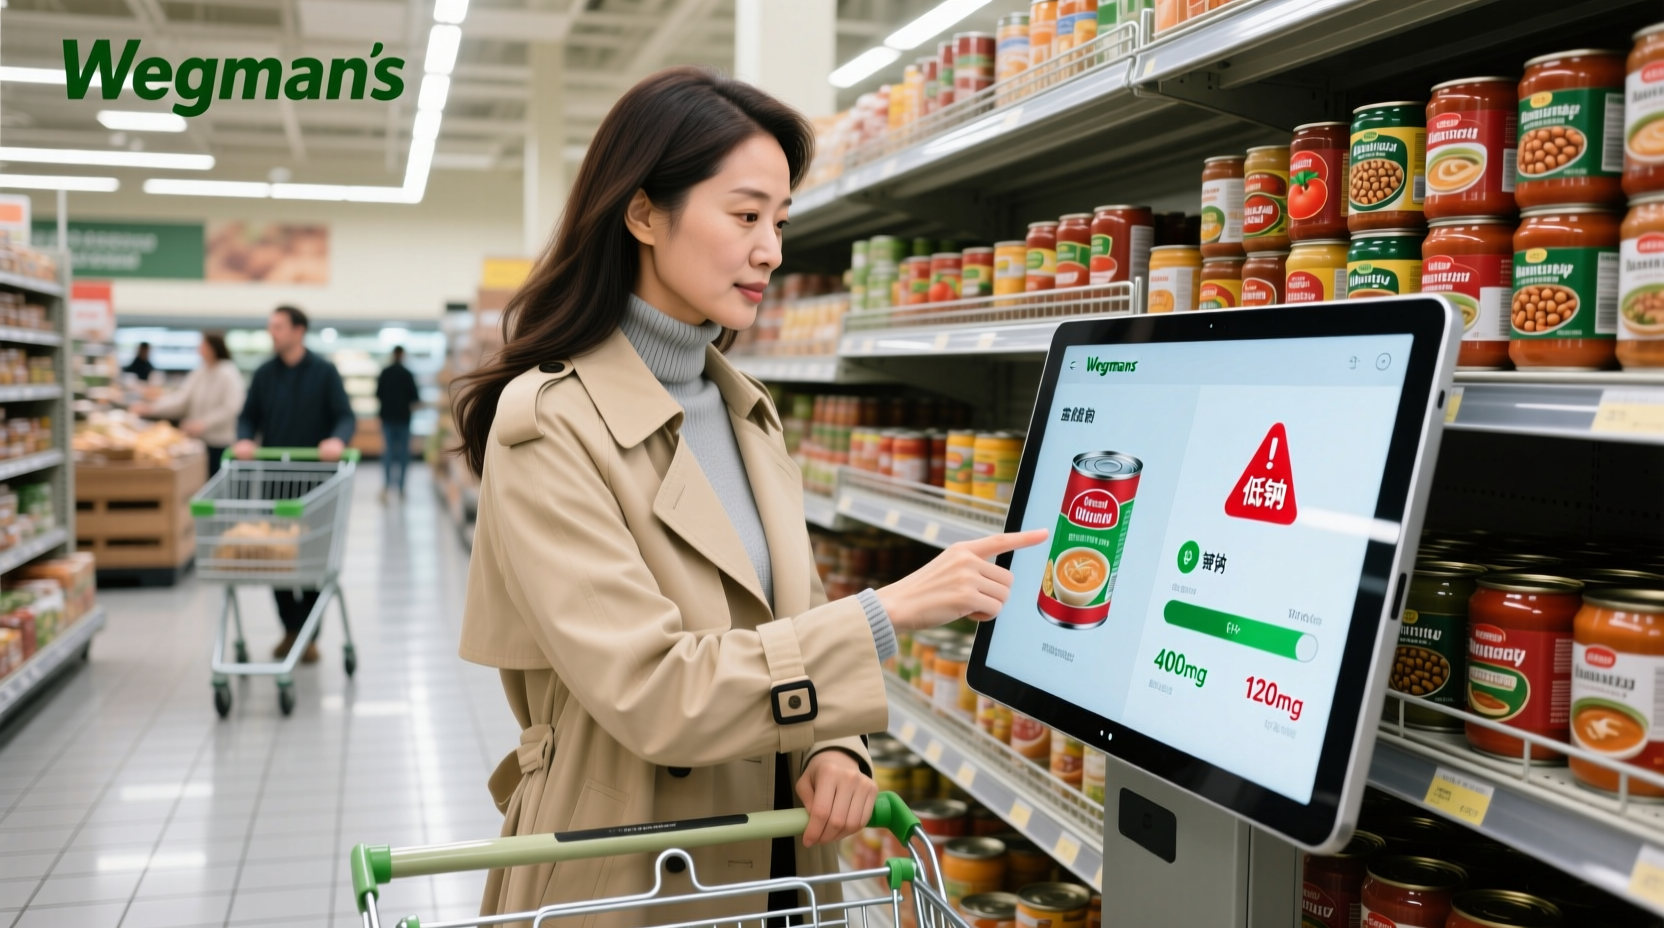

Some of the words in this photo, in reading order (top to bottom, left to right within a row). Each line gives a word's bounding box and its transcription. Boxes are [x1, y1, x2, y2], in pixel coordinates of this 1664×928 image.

[1086, 356, 1138, 376] Wegmans
[1153, 648, 1208, 689] 400mg
[1245, 676, 1304, 722] 120mg
